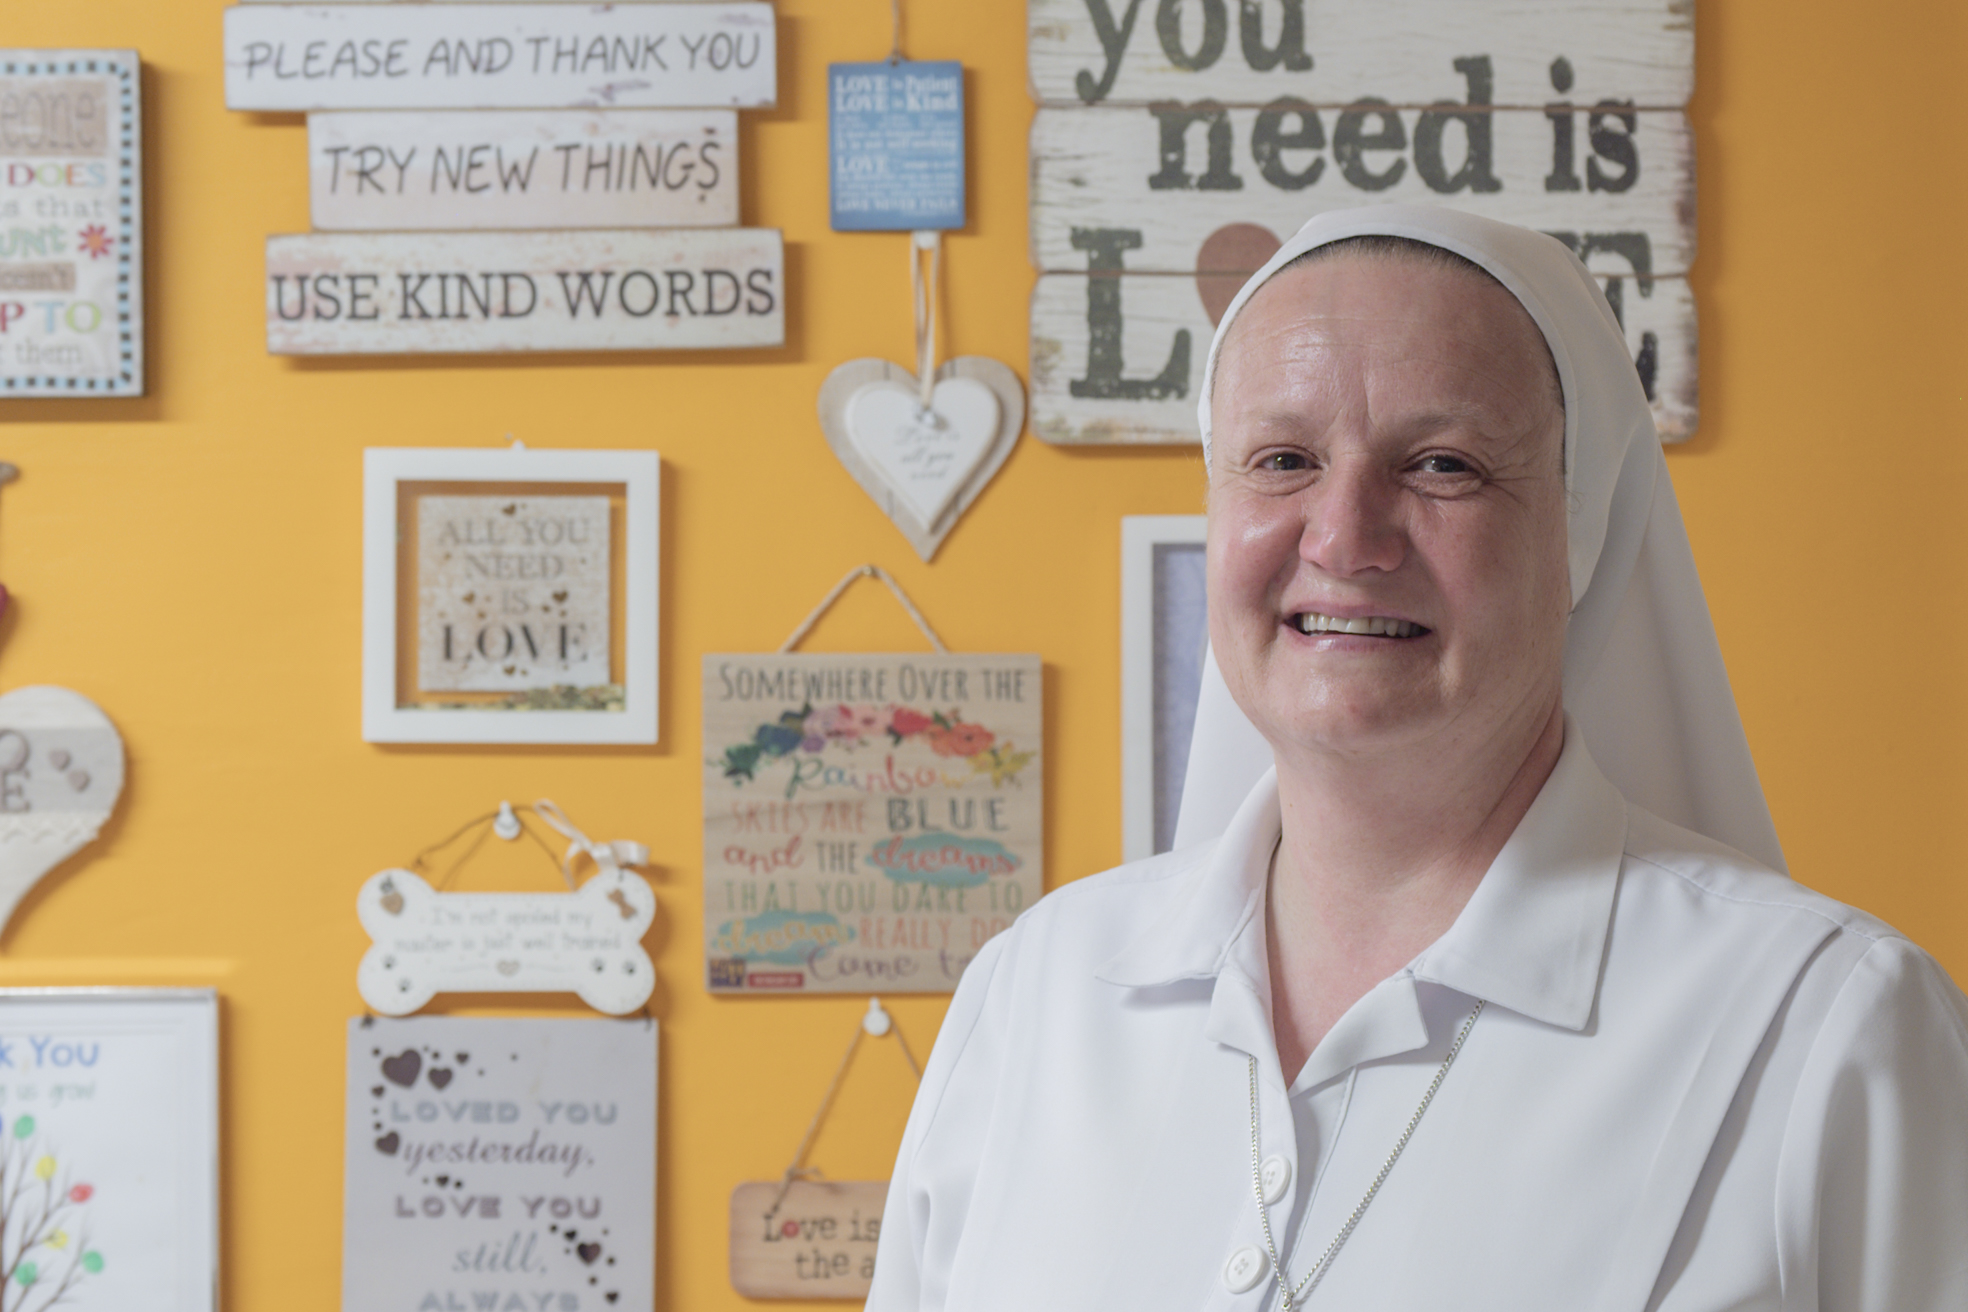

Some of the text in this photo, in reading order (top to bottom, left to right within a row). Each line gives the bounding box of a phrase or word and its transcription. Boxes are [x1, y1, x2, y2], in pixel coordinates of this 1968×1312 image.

[242, 32, 760, 79] PLEASE AND THANK YOU
[1075, 0, 1314, 105] you
[1147, 54, 1641, 194] need is
[8, 163, 107, 187] DOES
[323, 142, 720, 195] TRY NEW THINGS
[36, 194, 103, 218] that
[272, 269, 775, 321] USE KIND WORDS
[35, 301, 101, 334] TO
[16, 337, 82, 364] them
[437, 518, 591, 546] ALL YOU
[465, 554, 564, 580] NEED
[501, 588, 530, 616] IS
[442, 624, 587, 662] LOVE
[982, 667, 1025, 702] THE
[730, 798, 1010, 834] SKIES ARE BLUE
[723, 836, 1022, 875] and THE dreams
[724, 881, 1023, 914] THAT YOU DARE TO
[860, 917, 950, 949] REALLY
[807, 946, 919, 982] Come
[28, 1034, 99, 1067] You
[390, 1101, 617, 1124] LOVED YOU
[403, 1129, 594, 1177] yesterday,
[395, 1197, 601, 1219] LOVE YOU
[849, 1209, 881, 1242] is
[453, 1230, 547, 1274] still,
[796, 1248, 849, 1280] the
[419, 1291, 580, 1312] ALWAYS
